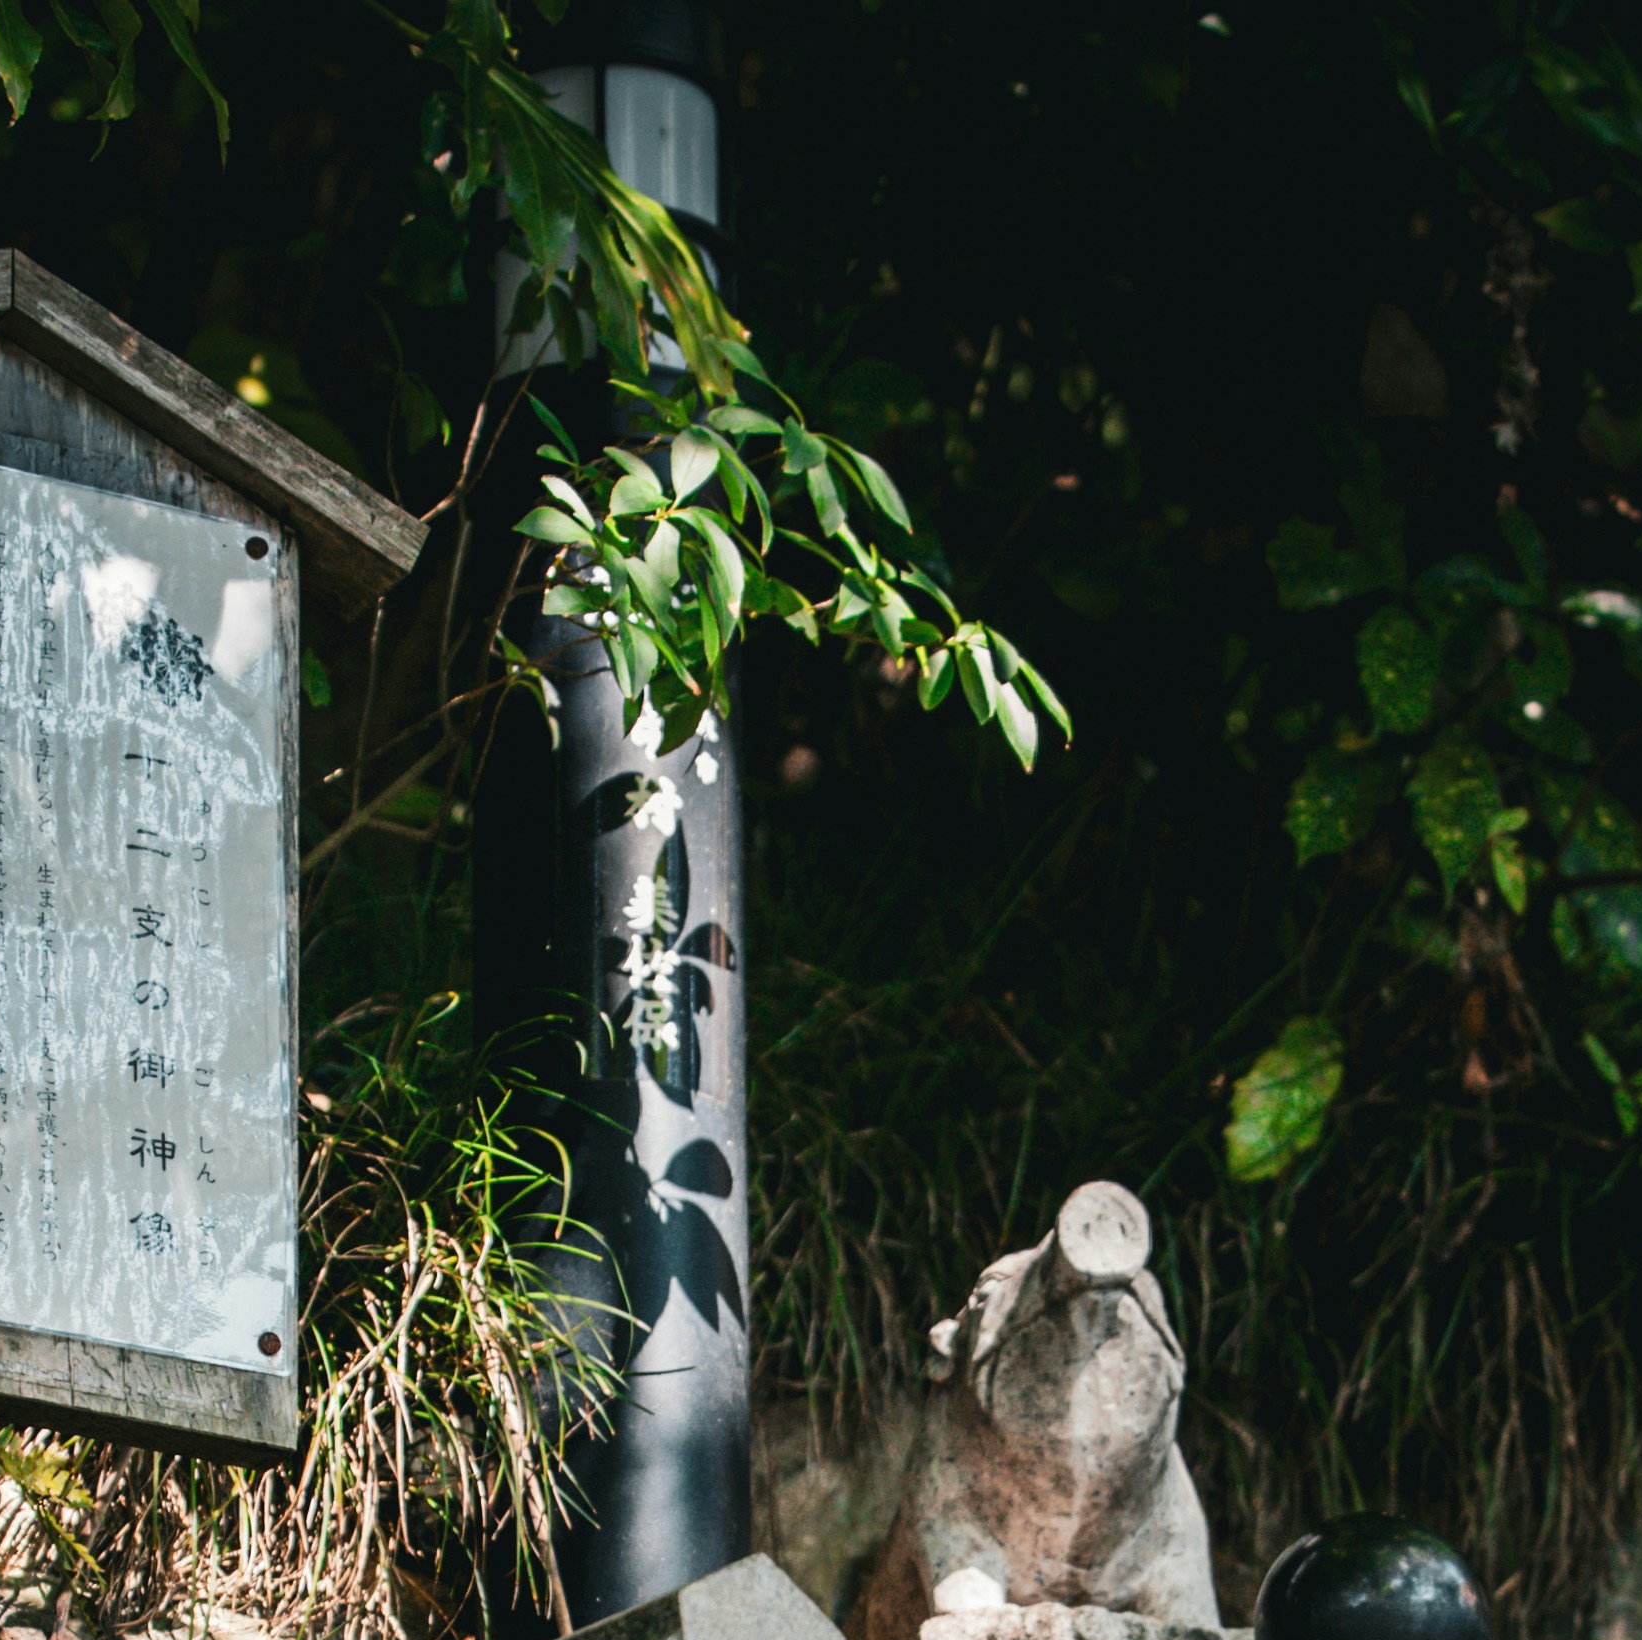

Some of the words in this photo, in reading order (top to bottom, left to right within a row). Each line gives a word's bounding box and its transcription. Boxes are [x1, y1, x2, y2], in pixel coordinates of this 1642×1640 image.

[124, 752, 178, 1257] 十二支の御神像
